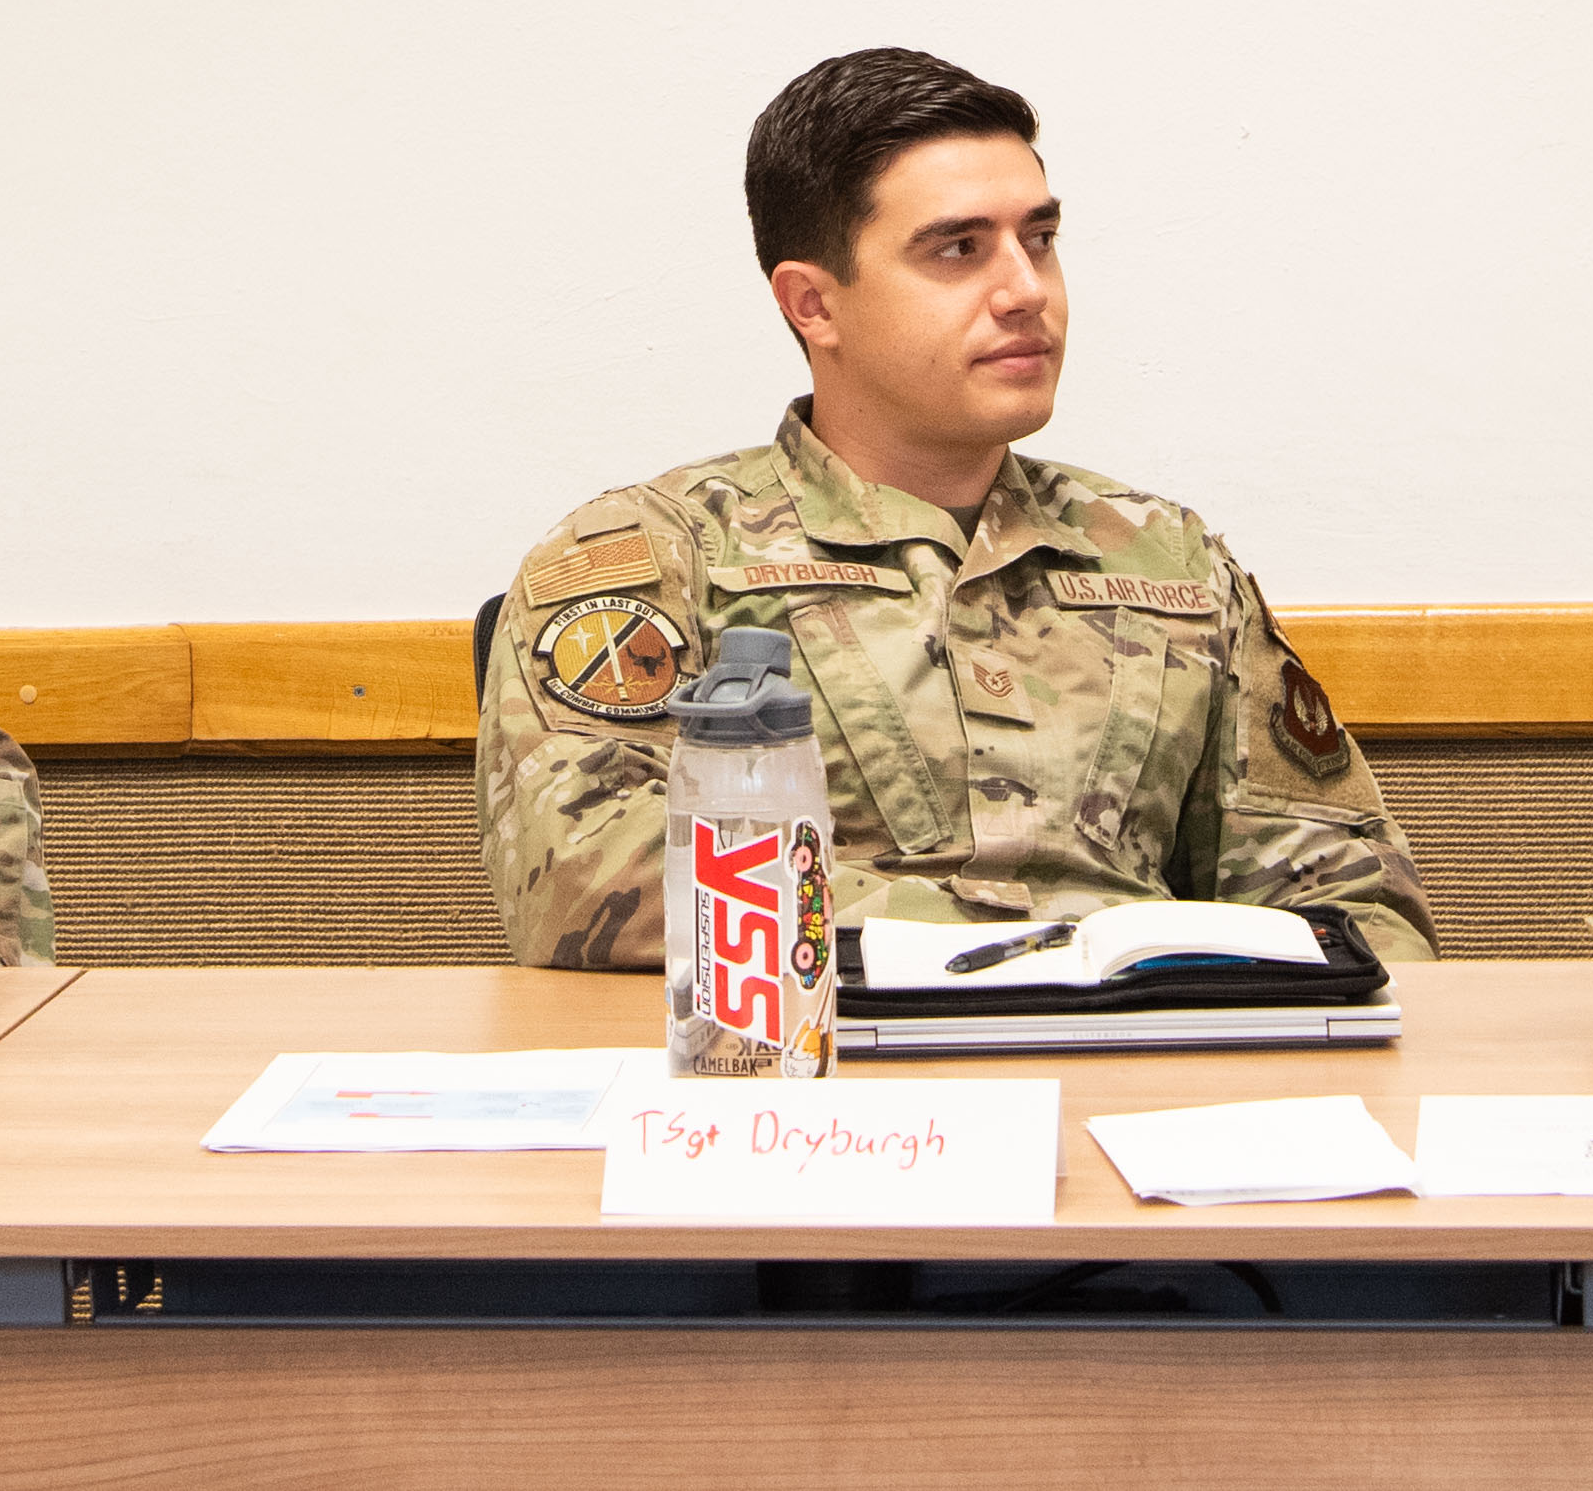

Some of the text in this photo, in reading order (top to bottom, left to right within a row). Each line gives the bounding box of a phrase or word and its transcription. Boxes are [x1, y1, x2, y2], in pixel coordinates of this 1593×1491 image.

[743, 563, 879, 586] DRYBURGH
[1058, 573, 1212, 609] U.S. AIR FORCE
[554, 598, 658, 628] FIRST IN LAST OUT
[560, 689, 602, 714] COMBAT
[695, 820, 780, 1042] YSS
[700, 891, 712, 1017] SUSPENSION
[693, 1055, 759, 1077] CAMELBAK
[631, 1109, 945, 1174] TSgt Dryburgh
